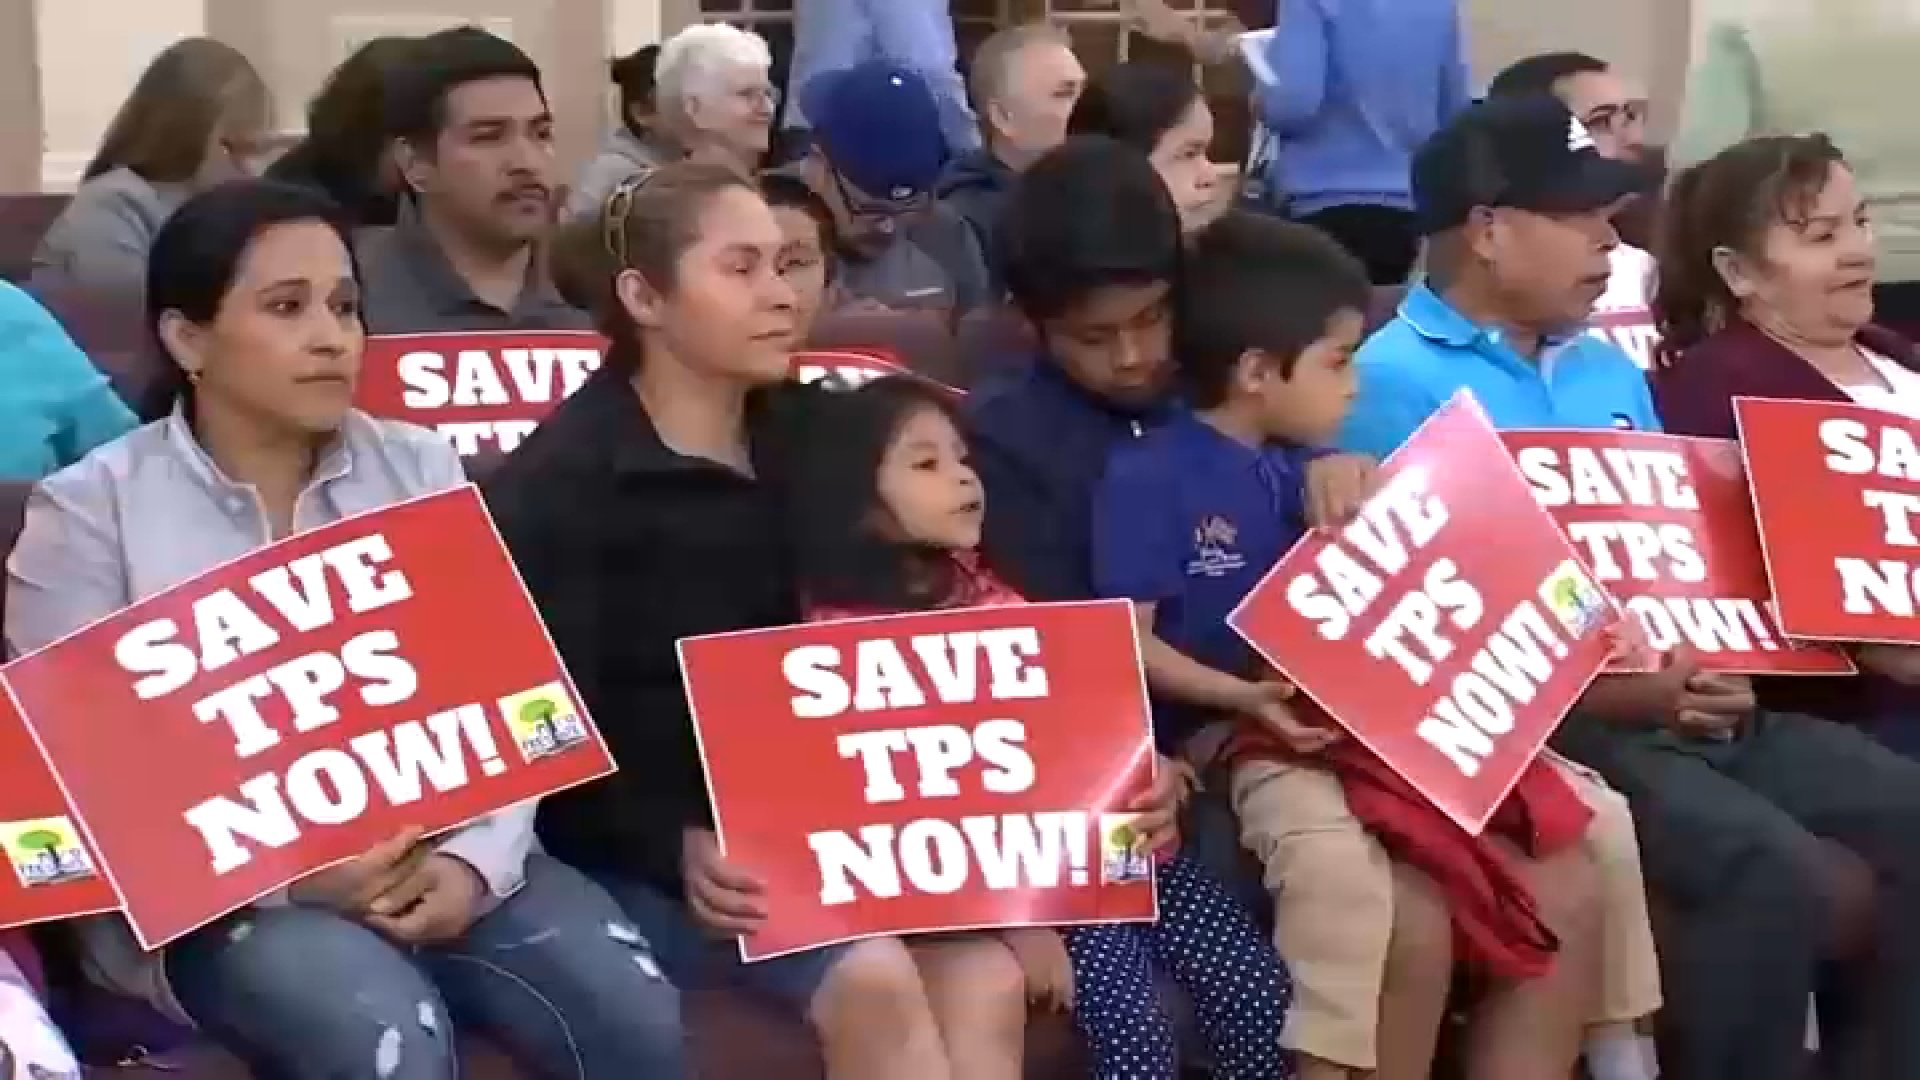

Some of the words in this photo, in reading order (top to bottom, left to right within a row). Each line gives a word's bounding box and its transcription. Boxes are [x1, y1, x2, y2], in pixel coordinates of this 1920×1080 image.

[1519, 447, 1700, 511] SAVE
[1287, 464, 1449, 641] SAVE
[1568, 521, 1707, 582] TPS
[114, 533, 412, 699] SAVE
[1364, 557, 1484, 687] TPS
[1626, 595, 1780, 652] OW!
[192, 629, 418, 759] TPS
[783, 627, 1049, 718] SAVE
[1415, 599, 1569, 778] NOW!
[183, 703, 507, 876] NOW!
[836, 719, 1036, 803] TPS
[807, 810, 1089, 905] NOW!
